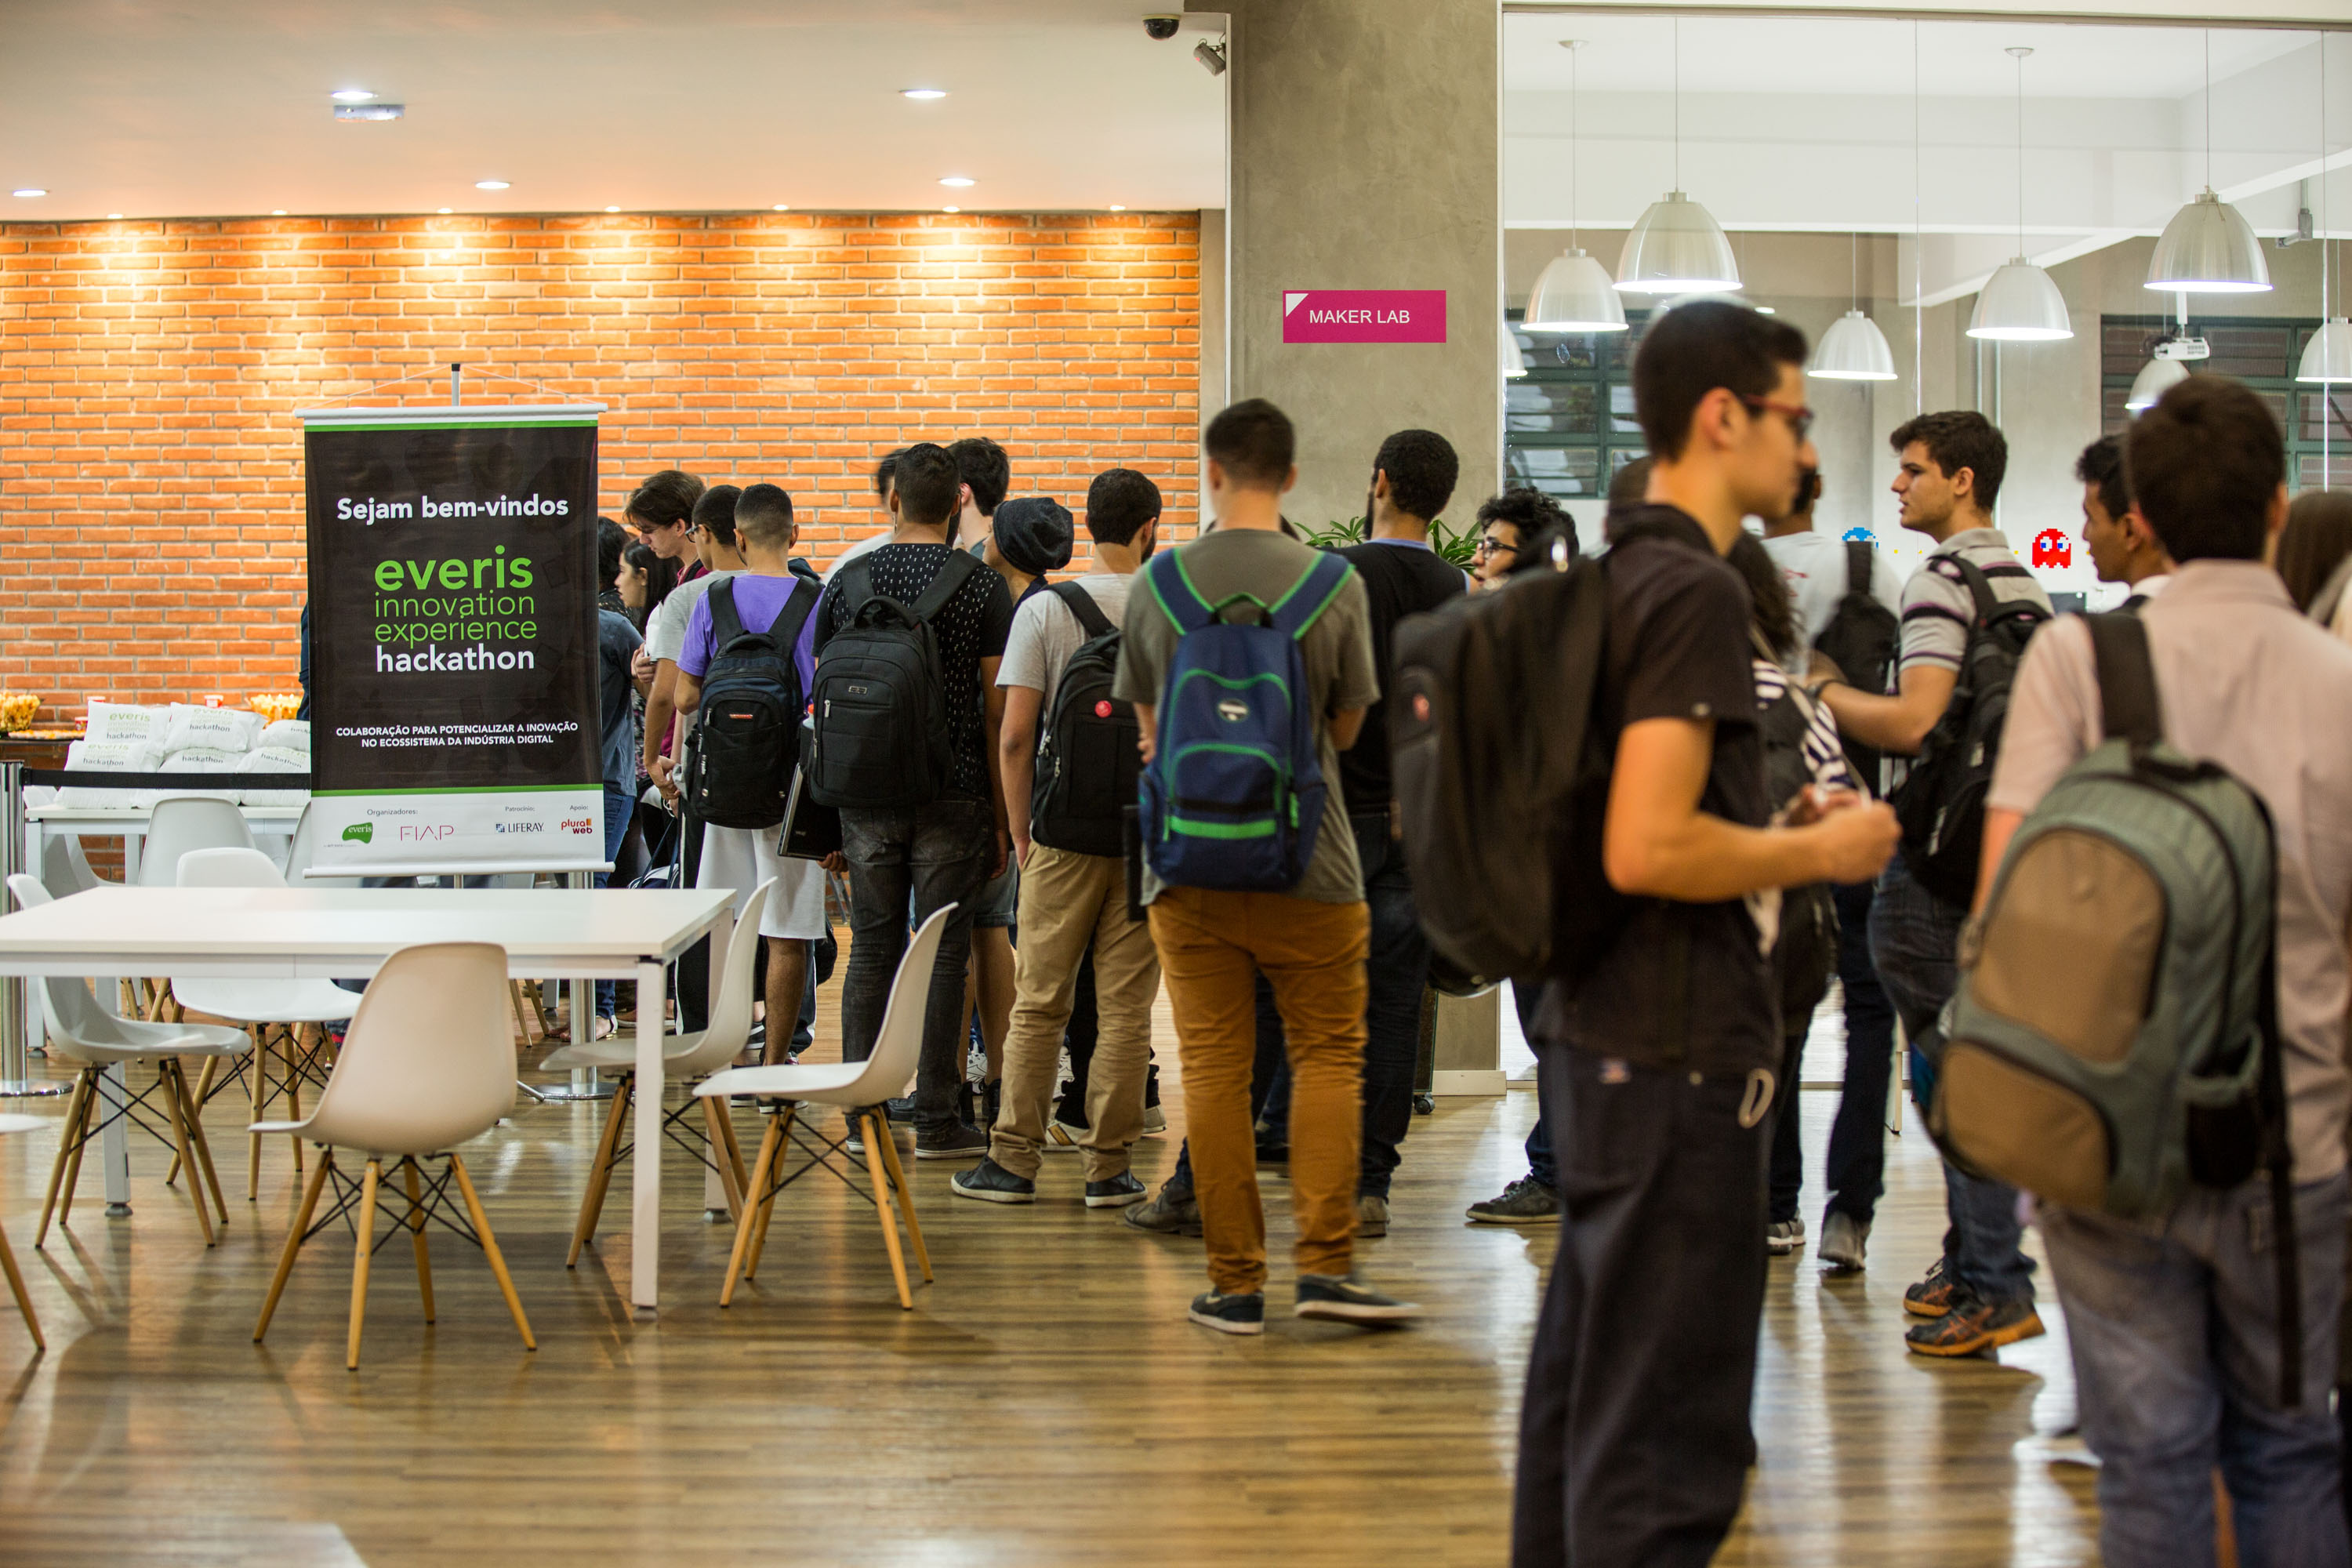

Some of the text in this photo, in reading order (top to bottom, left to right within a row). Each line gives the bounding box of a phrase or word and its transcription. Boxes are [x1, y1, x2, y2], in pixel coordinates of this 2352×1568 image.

[1309, 310, 1410, 324] MAKER LAB
[337, 494, 569, 525] Sejam bem-vindos
[375, 545, 533, 591] everis
[375, 590, 535, 618] innovation
[375, 615, 537, 649] experience
[376, 643, 535, 673] hackathon
[190, 724, 230, 732] hackathon
[336, 720, 579, 737] COLABORAÇÃO PARA POTENCIALIZAR A INOVAÇÃO
[361, 734, 554, 748] NO ECOSSISTEMA DA INDÚSTRIA DIGITAL
[82, 757, 124, 766] hackathon
[181, 755, 223, 764] hackathon
[367, 808, 419, 817] Organizadores:
[348, 825, 372, 833] everis
[400, 825, 455, 841] FIAP
[508, 822, 544, 833] LIFERAY
